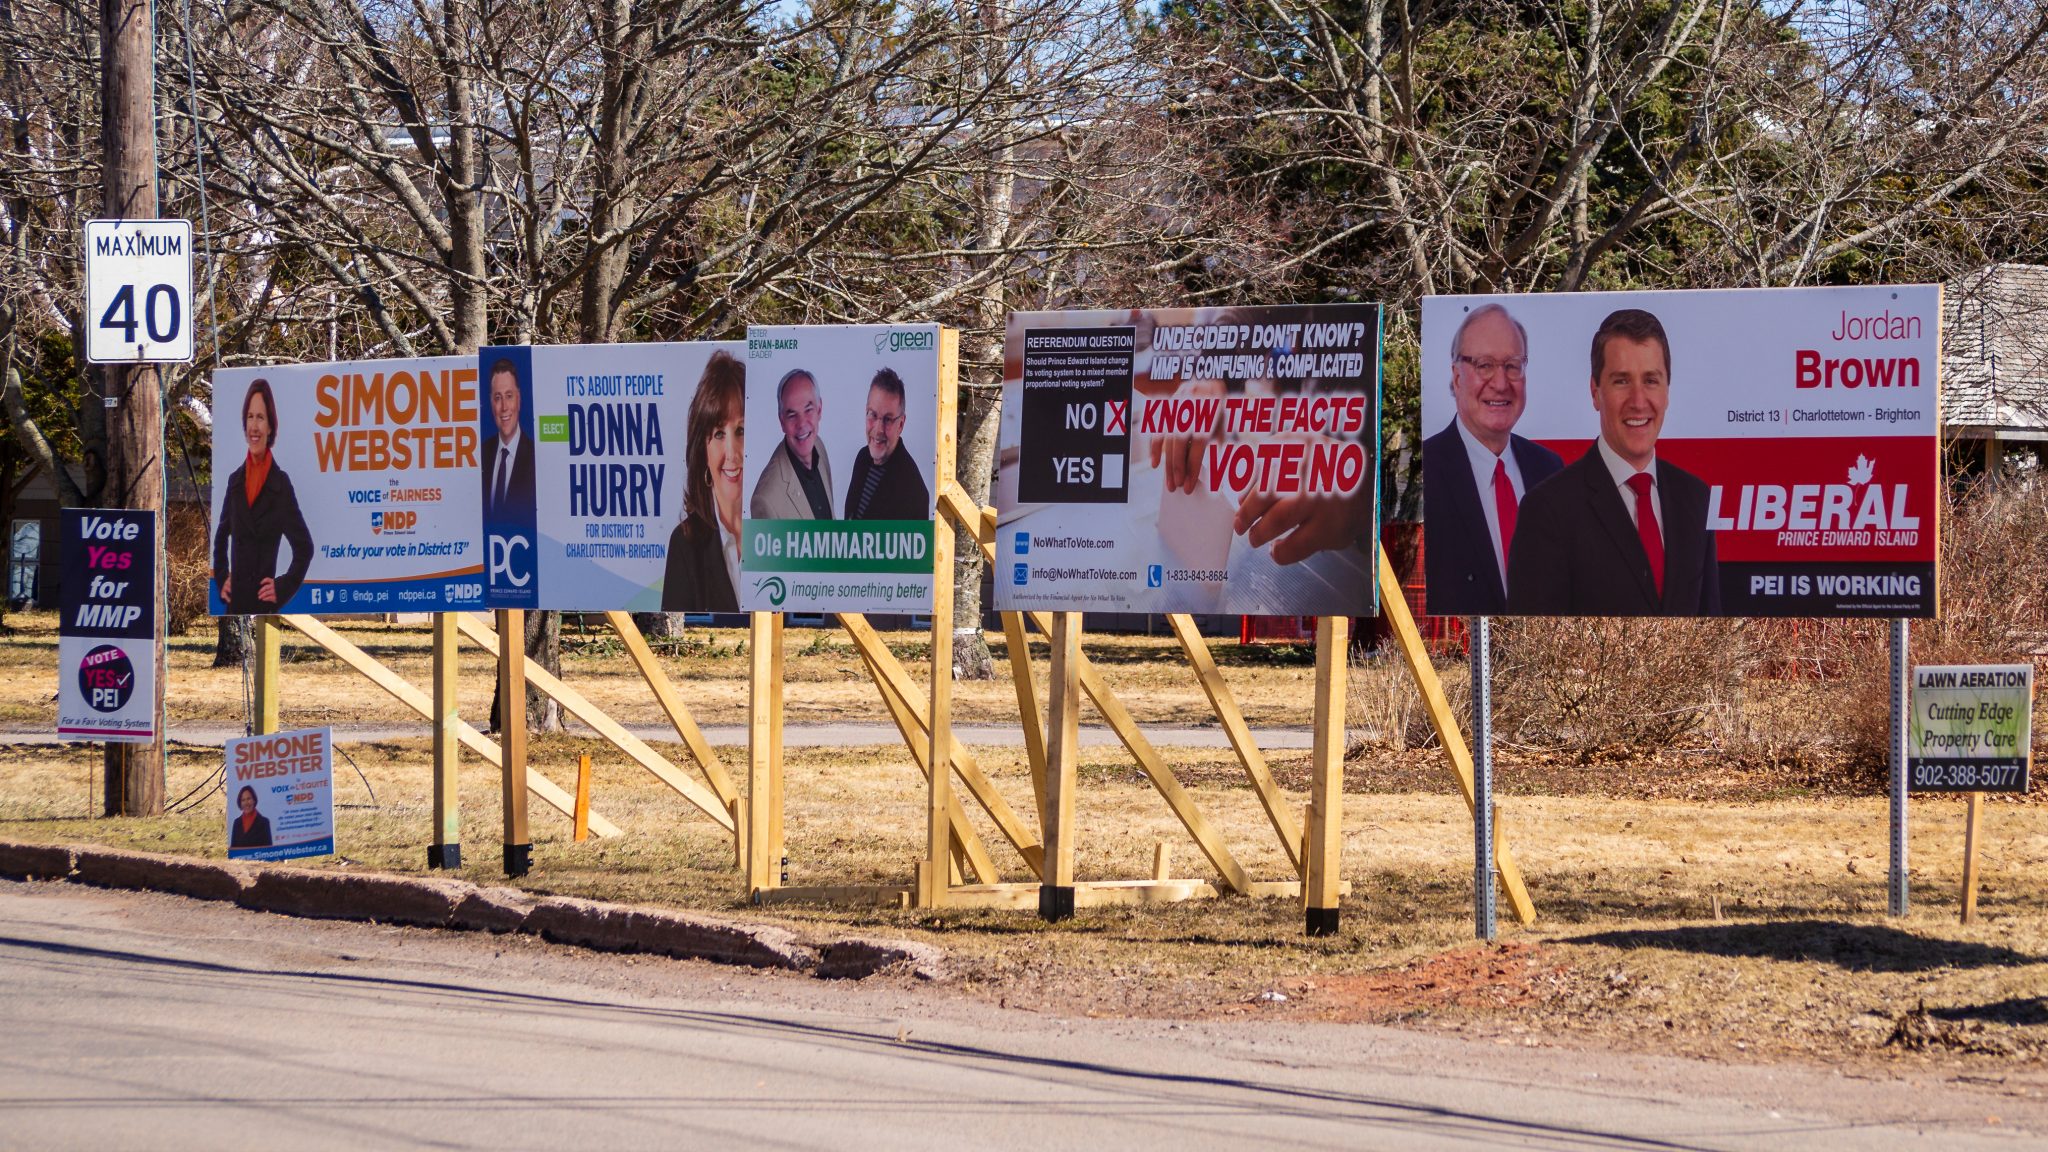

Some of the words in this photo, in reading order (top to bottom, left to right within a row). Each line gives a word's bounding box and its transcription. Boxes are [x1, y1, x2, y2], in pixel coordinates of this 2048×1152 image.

[97, 236, 181, 256] MAXIMUM
[100, 284, 181, 342] 40
[749, 329, 767, 337] PETER
[1832, 310, 1921, 341] Jordan
[749, 340, 798, 349] BEVAN-BAKER
[890, 331, 933, 352] green
[1027, 336, 1087, 348] REFERENDUM
[1089, 336, 1133, 347] QUESTION
[1153, 324, 1250, 350] UNDECIDED?
[1252, 324, 1301, 349] DON'T
[1302, 323, 1365, 348] KNOW?
[1026, 357, 1047, 366] Should
[1048, 357, 1066, 365] Prince
[1067, 357, 1089, 365] Edward
[1090, 356, 1107, 365] Island
[1108, 356, 1129, 365] change
[1151, 356, 1180, 380] MMP
[1181, 356, 1194, 379] IS
[1196, 354, 1265, 379] CONFUSING
[1266, 357, 1274, 378] &
[1276, 353, 1363, 378] COMPLICATED
[1795, 350, 1920, 389] Brown
[1035, 369, 1052, 378] voting
[1053, 369, 1074, 377] system
[1087, 368, 1105, 376] mixed
[567, 376, 585, 397] IT'S
[588, 375, 622, 396] ABOUT
[625, 375, 664, 396] PEOPLE
[1026, 379, 1060, 389] proportional
[1061, 379, 1079, 389] voting
[1080, 379, 1105, 388] system?
[314, 369, 478, 428] SIMONE
[1066, 403, 1097, 429] NO
[1141, 399, 1219, 433] KNOW
[1225, 398, 1276, 433] THE
[1277, 397, 1365, 433] FACTS
[1728, 410, 1765, 422] District
[1768, 410, 1780, 422] 13
[1792, 409, 1865, 422] Charlottetown
[1875, 408, 1920, 424] Brighton
[543, 423, 565, 434] ELECT
[568, 403, 664, 456] DONNA
[314, 427, 478, 473] WEBSTER
[1052, 457, 1095, 484] YES
[1209, 443, 1305, 492] VOTE
[1308, 443, 1364, 492] NO
[389, 478, 399, 486] the
[569, 463, 666, 517] HURRY
[348, 490, 381, 503] VOICE
[382, 492, 389, 500] of
[390, 488, 442, 502] FAIRNESS
[1706, 484, 1920, 531] LIBERAL
[81, 516, 139, 540] Vote
[384, 511, 416, 529] NDP
[586, 524, 599, 538] FOR
[602, 524, 634, 538] DISTRICT
[636, 524, 644, 538] 13
[1777, 531, 1818, 546] PRINCE
[1822, 531, 1870, 546] EDWARD
[1874, 531, 1918, 546] ISLAND
[330, 545, 346, 558] ask
[347, 544, 361, 558] for
[362, 546, 384, 560] your
[385, 544, 405, 557] vote
[408, 543, 416, 556] in
[418, 542, 451, 556] District
[566, 543, 665, 559] CHARLOTTETOWN-BRIGHTON
[754, 533, 782, 557] Ole
[786, 531, 926, 560] HAMMARLUND
[1033, 537, 1114, 549] NoWhatToVote.com
[88, 546, 133, 569] Yes
[489, 534, 531, 587] PC
[1032, 568, 1137, 581] info@NoWhatToVote.com
[1166, 570, 1228, 582] 1-833-843-8684
[89, 575, 129, 598] for
[352, 589, 389, 603] @ndp_pei
[399, 589, 436, 602] ndppei.ca
[454, 583, 482, 599] NDP
[791, 581, 834, 600] imagine
[837, 582, 893, 602] something
[896, 582, 927, 599] better
[1751, 576, 1784, 595] PEI
[1791, 575, 1810, 595] IS
[1817, 575, 1920, 596] WORKING
[75, 604, 141, 628] MMP
[86, 649, 119, 666] VOTE
[85, 669, 115, 688] YES
[1919, 673, 1957, 688] LAWN
[1959, 672, 2026, 687] AERATION
[92, 688, 118, 708] PEI
[61, 717, 74, 725] For
[82, 718, 97, 726] Fair
[98, 718, 122, 728] Voting
[124, 719, 150, 729] System
[1928, 702, 1975, 725] Cutting
[1978, 702, 2013, 725] Edge
[235, 733, 323, 764] SIMONE
[1923, 730, 1980, 752] Property
[1984, 729, 2016, 747] Care
[235, 755, 323, 781] WEBSTER
[1915, 765, 2019, 786] 902-388-5077
[271, 785, 289, 793] VOIX
